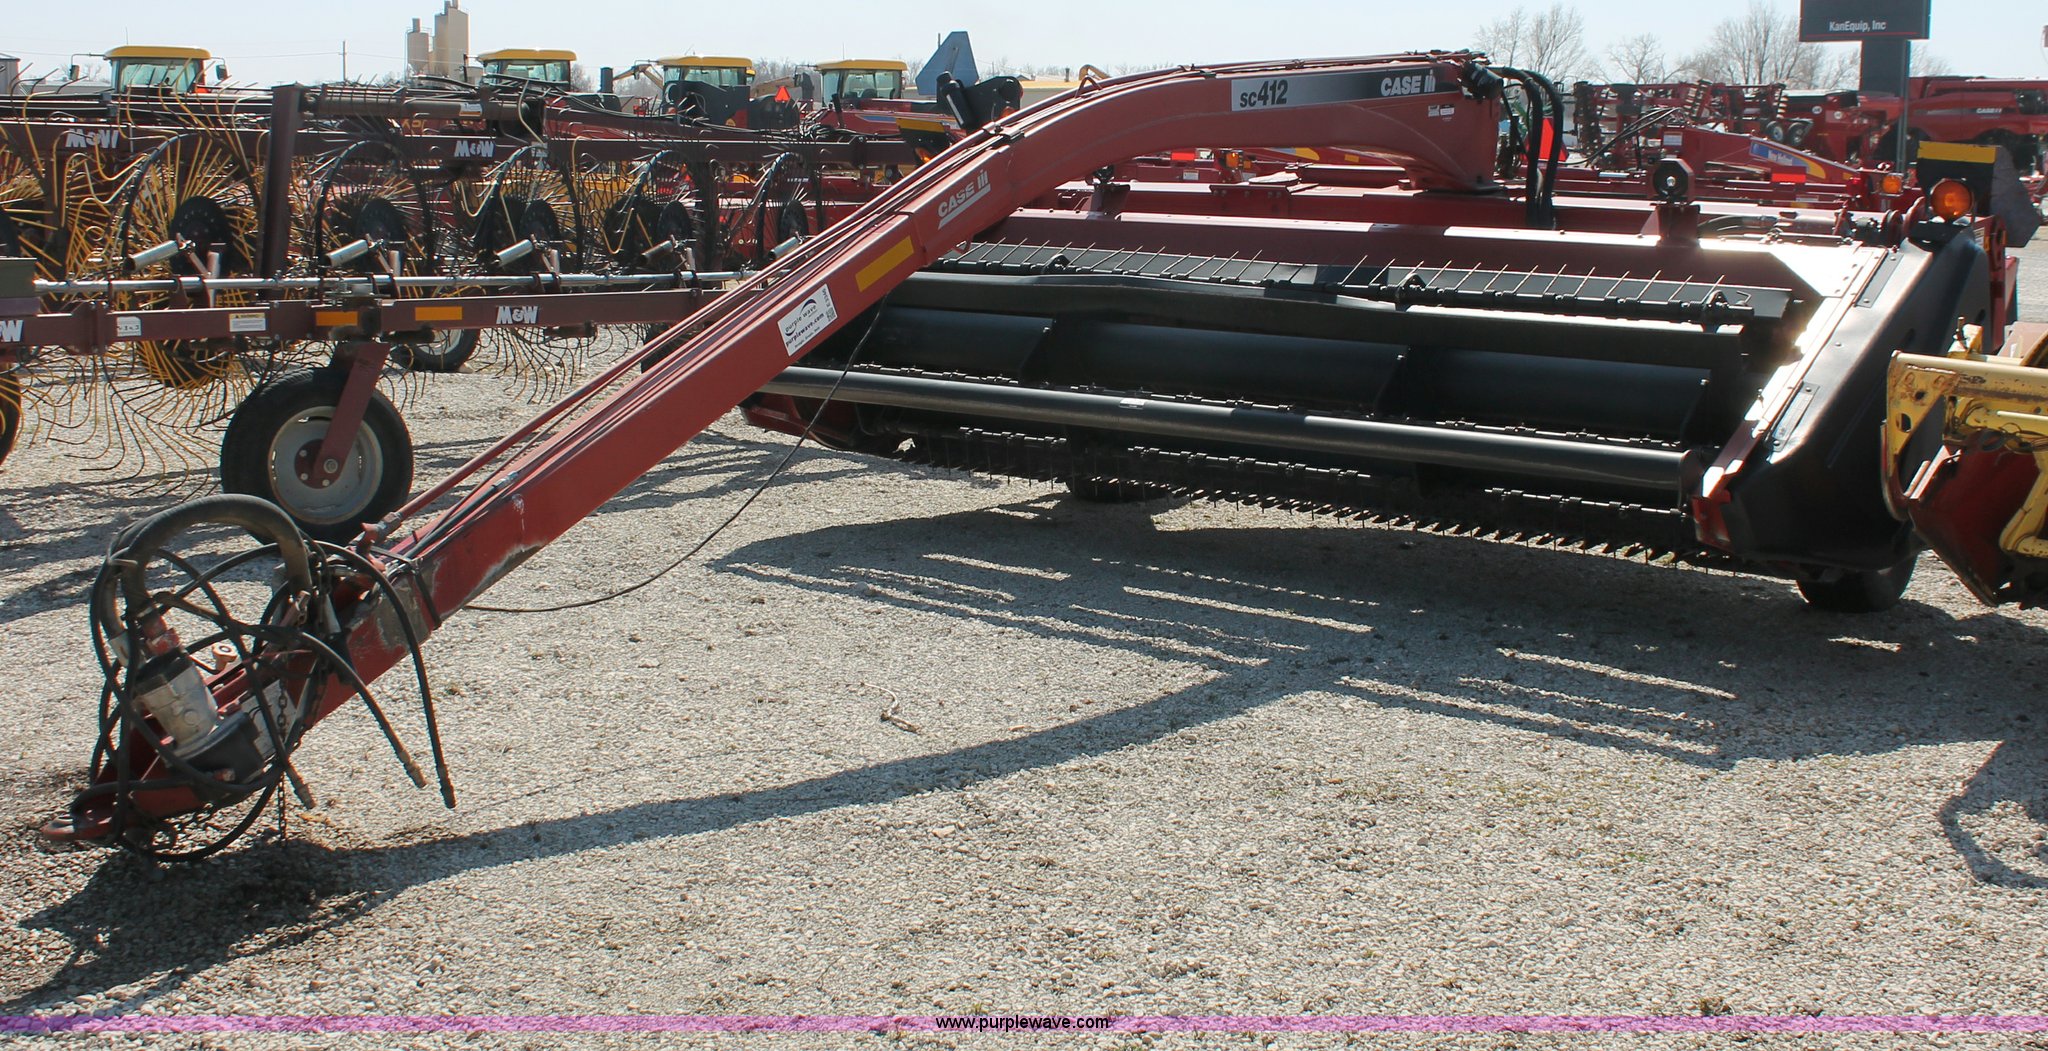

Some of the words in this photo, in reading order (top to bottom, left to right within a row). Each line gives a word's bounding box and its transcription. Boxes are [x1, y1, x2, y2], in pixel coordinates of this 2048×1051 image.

[1829, 21, 1870, 32] KanEquip,
[1872, 20, 1886, 30] Inc
[1381, 76, 1421, 97] CASE
[454, 140, 495, 158] M&W
[938, 181, 976, 217] CASE
[496, 305, 538, 325] M&W
[785, 316, 802, 332] purple
[803, 305, 817, 318] wave
[786, 313, 824, 347] purplewave.com
